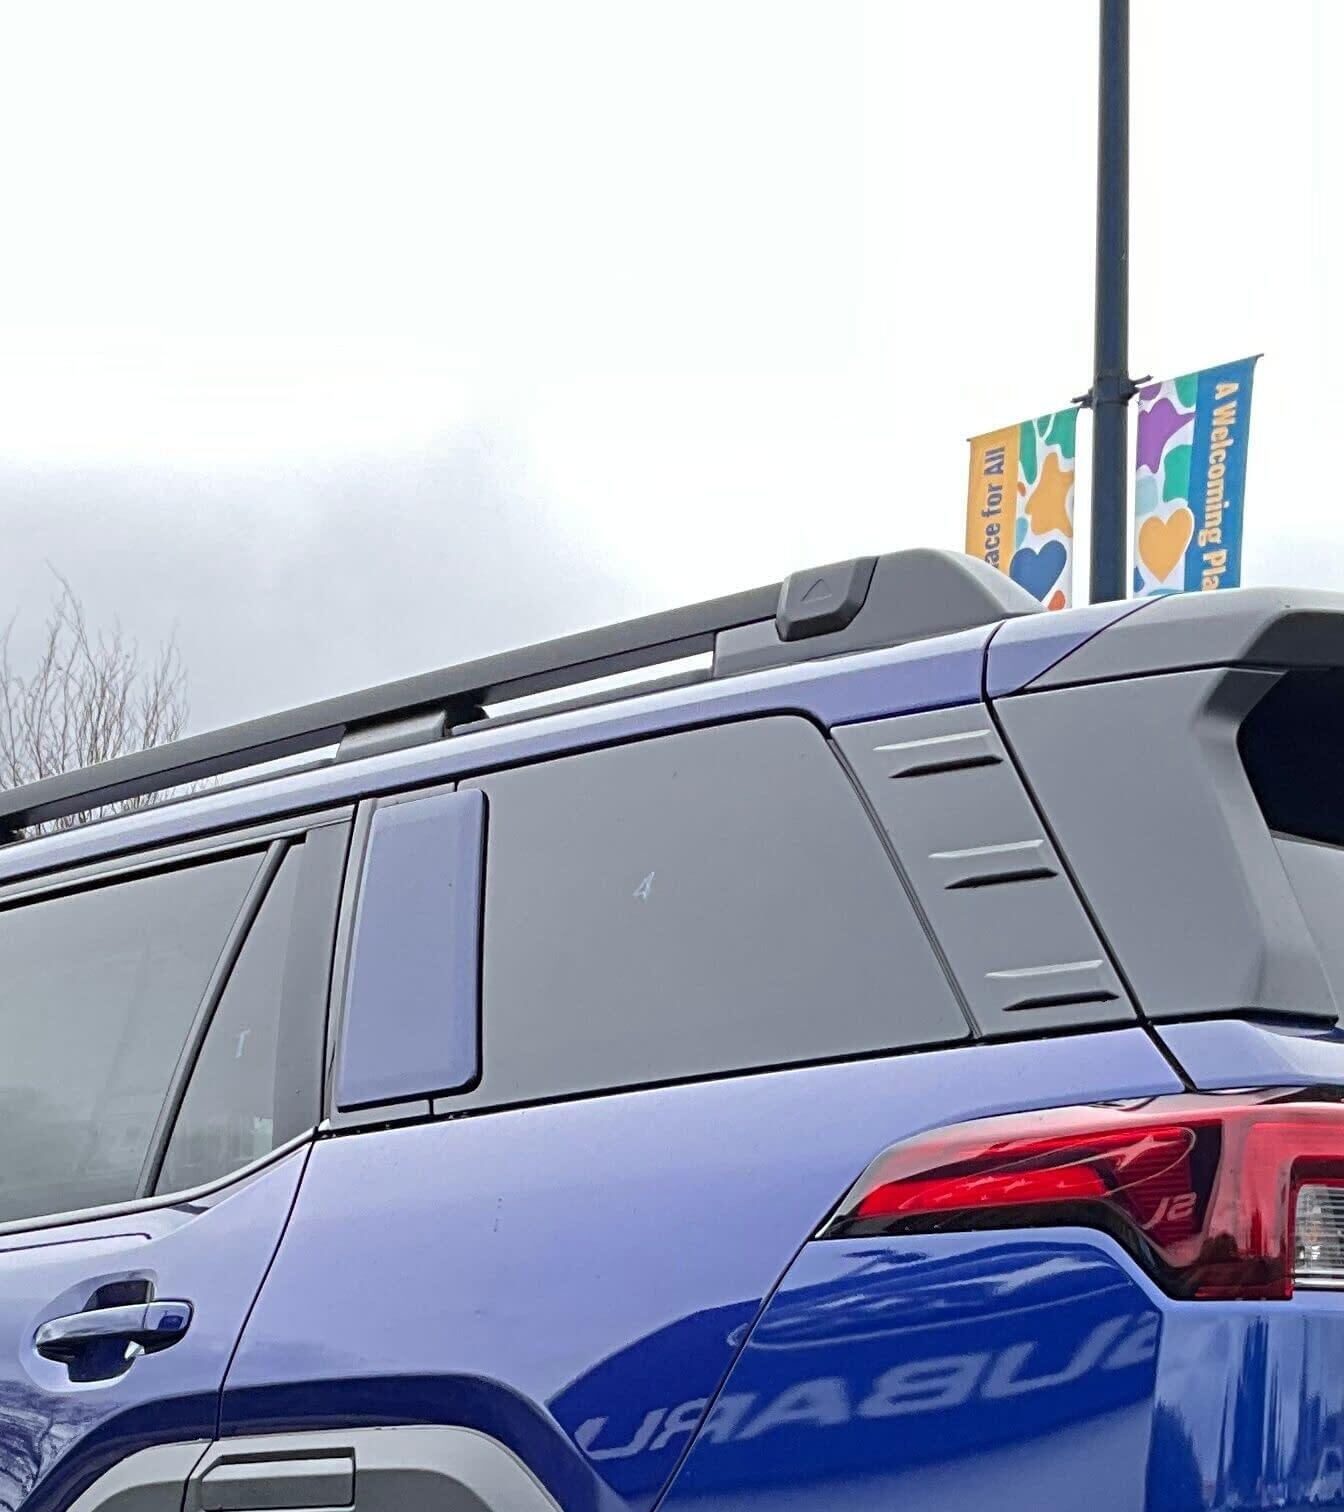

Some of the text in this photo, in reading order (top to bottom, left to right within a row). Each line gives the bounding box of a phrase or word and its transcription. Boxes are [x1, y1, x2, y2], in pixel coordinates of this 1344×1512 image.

[981, 446, 1005, 568] ace for All
[1198, 383, 1239, 592] A Welcoming Pla
